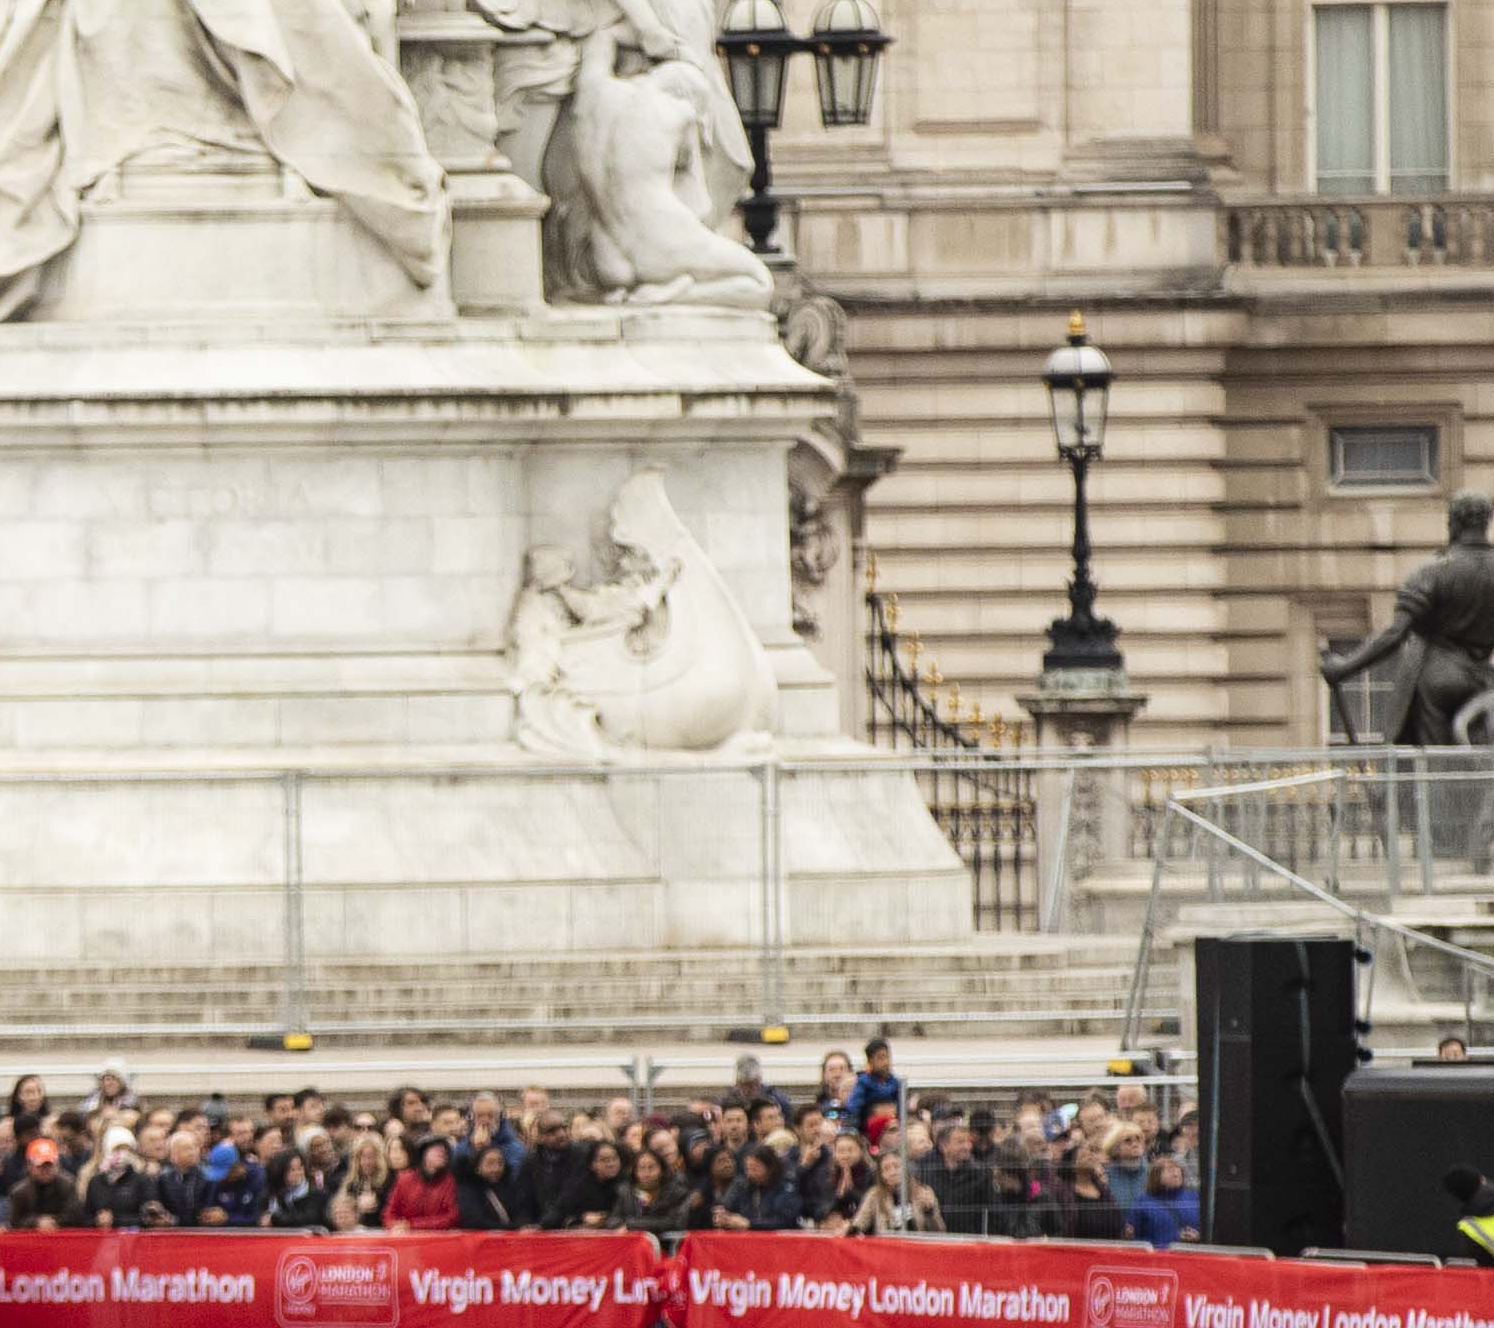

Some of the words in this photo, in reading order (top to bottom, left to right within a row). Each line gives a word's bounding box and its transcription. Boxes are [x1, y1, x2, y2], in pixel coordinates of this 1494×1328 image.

[110, 1266, 256, 1304] Marathon
[409, 1268, 495, 1316] Virgin
[501, 1269, 609, 1313] Money
[688, 1268, 773, 1318] Virgin
[777, 1272, 866, 1320] Money
[868, 1275, 955, 1318] London
[958, 1280, 1071, 1323] Marathon
